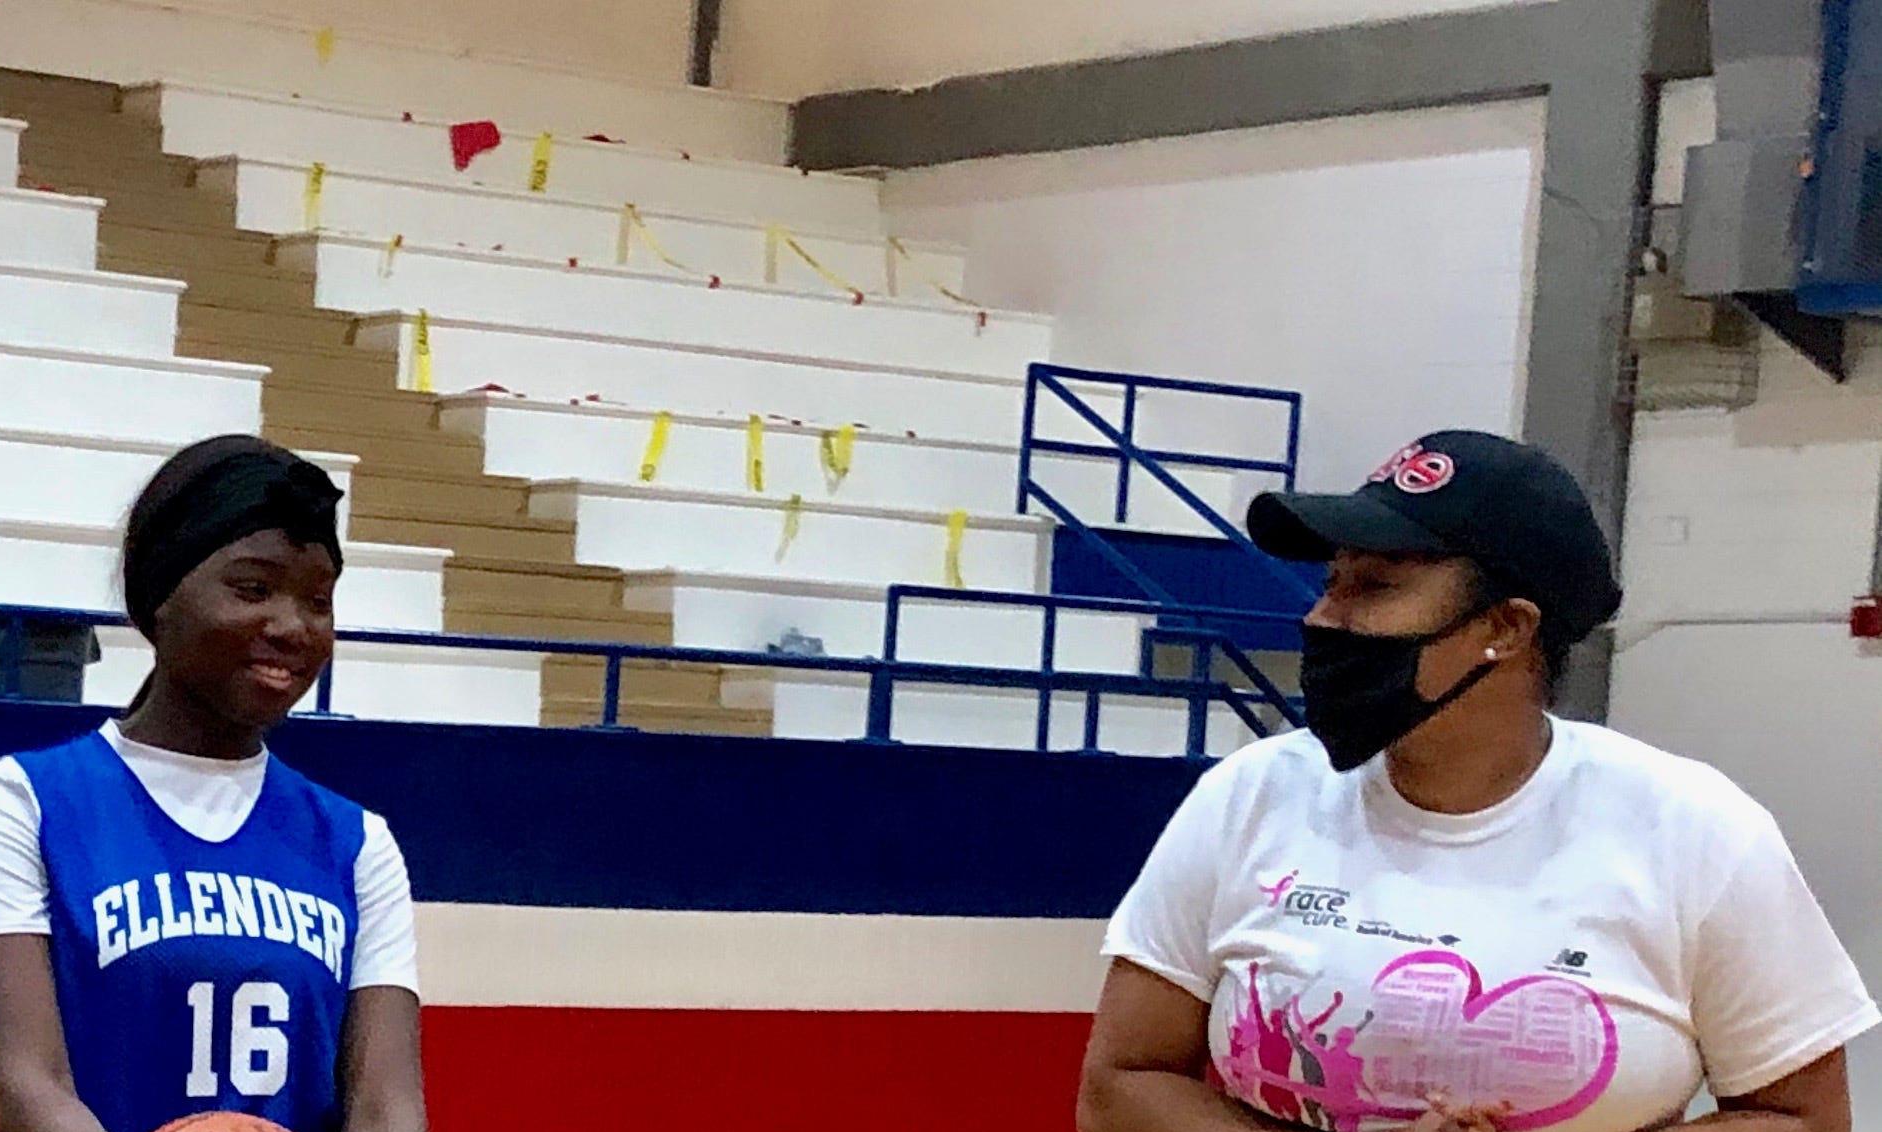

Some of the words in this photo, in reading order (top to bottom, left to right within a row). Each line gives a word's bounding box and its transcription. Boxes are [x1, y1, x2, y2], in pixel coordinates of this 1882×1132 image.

[92, 871, 346, 984] ELLENDER
[1285, 889, 1346, 913] race
[186, 981, 289, 1098] 16
